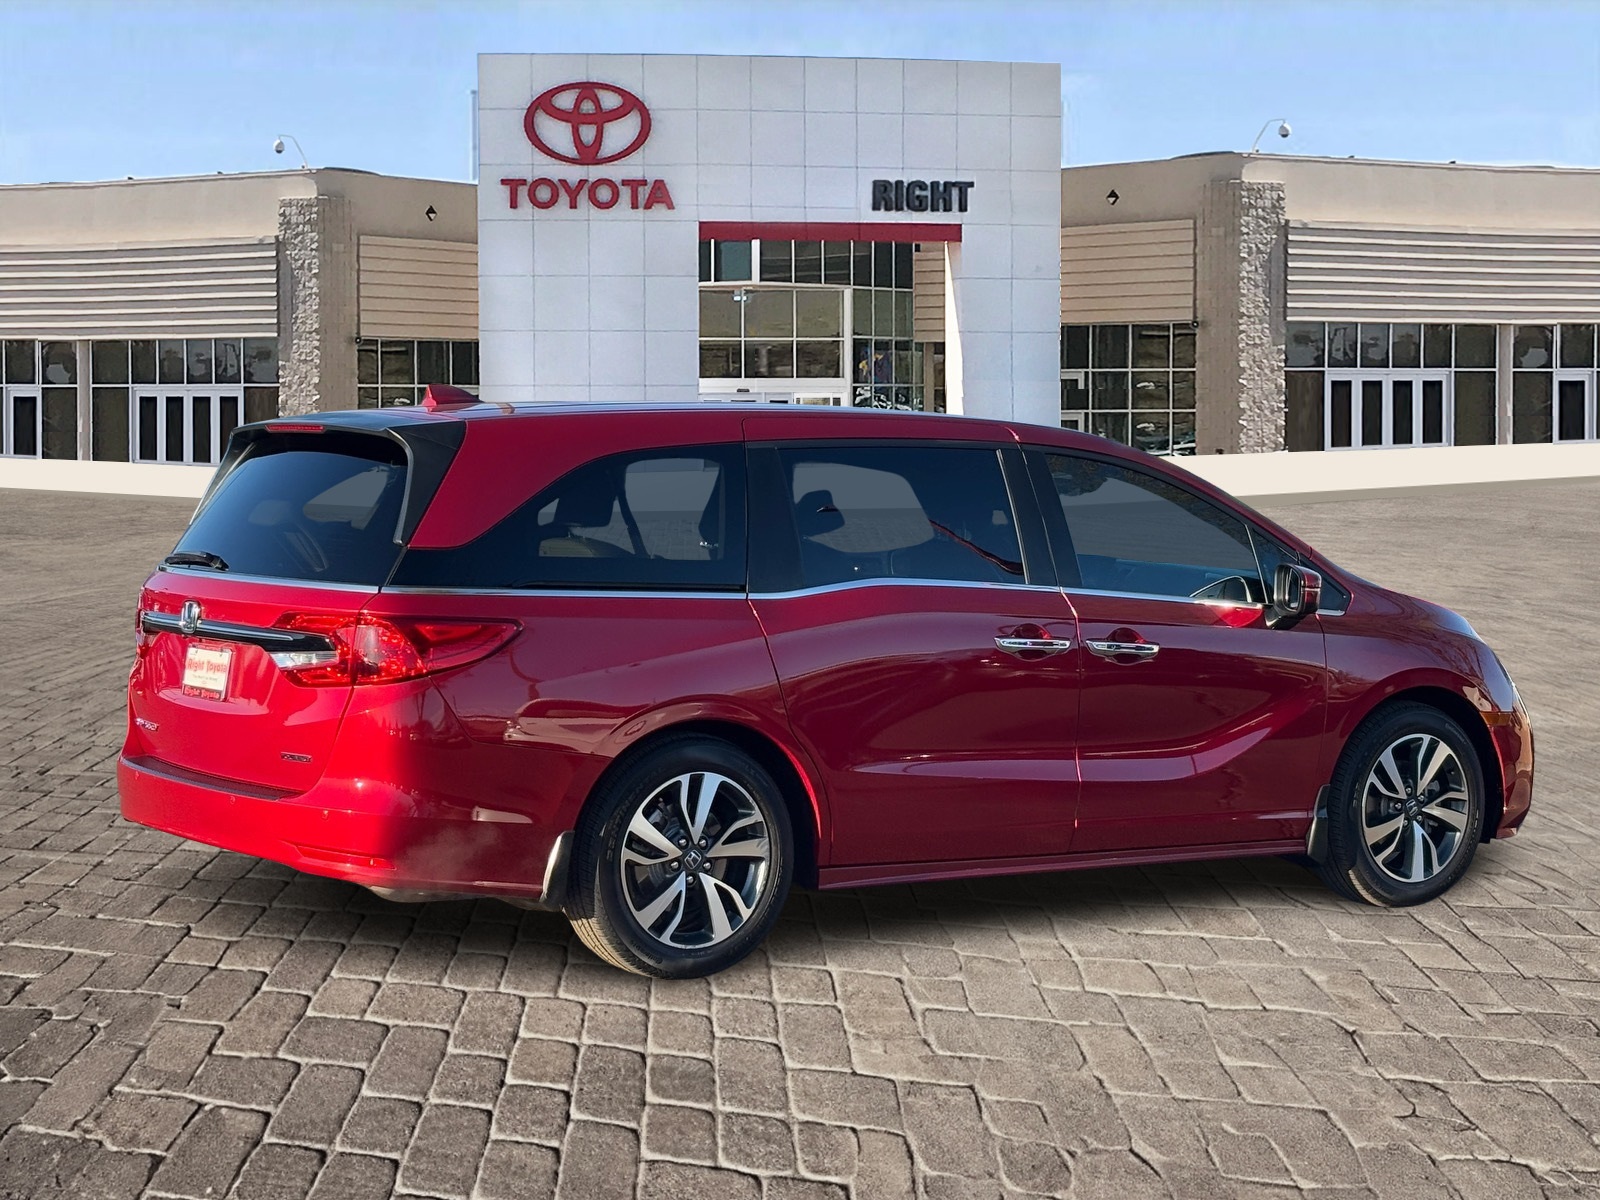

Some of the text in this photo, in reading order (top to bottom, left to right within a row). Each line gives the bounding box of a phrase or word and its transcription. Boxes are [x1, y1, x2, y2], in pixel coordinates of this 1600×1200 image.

[500, 177, 675, 210] TOYOTA
[872, 179, 975, 212] RIGHT
[187, 658, 227, 675] Right Toyota
